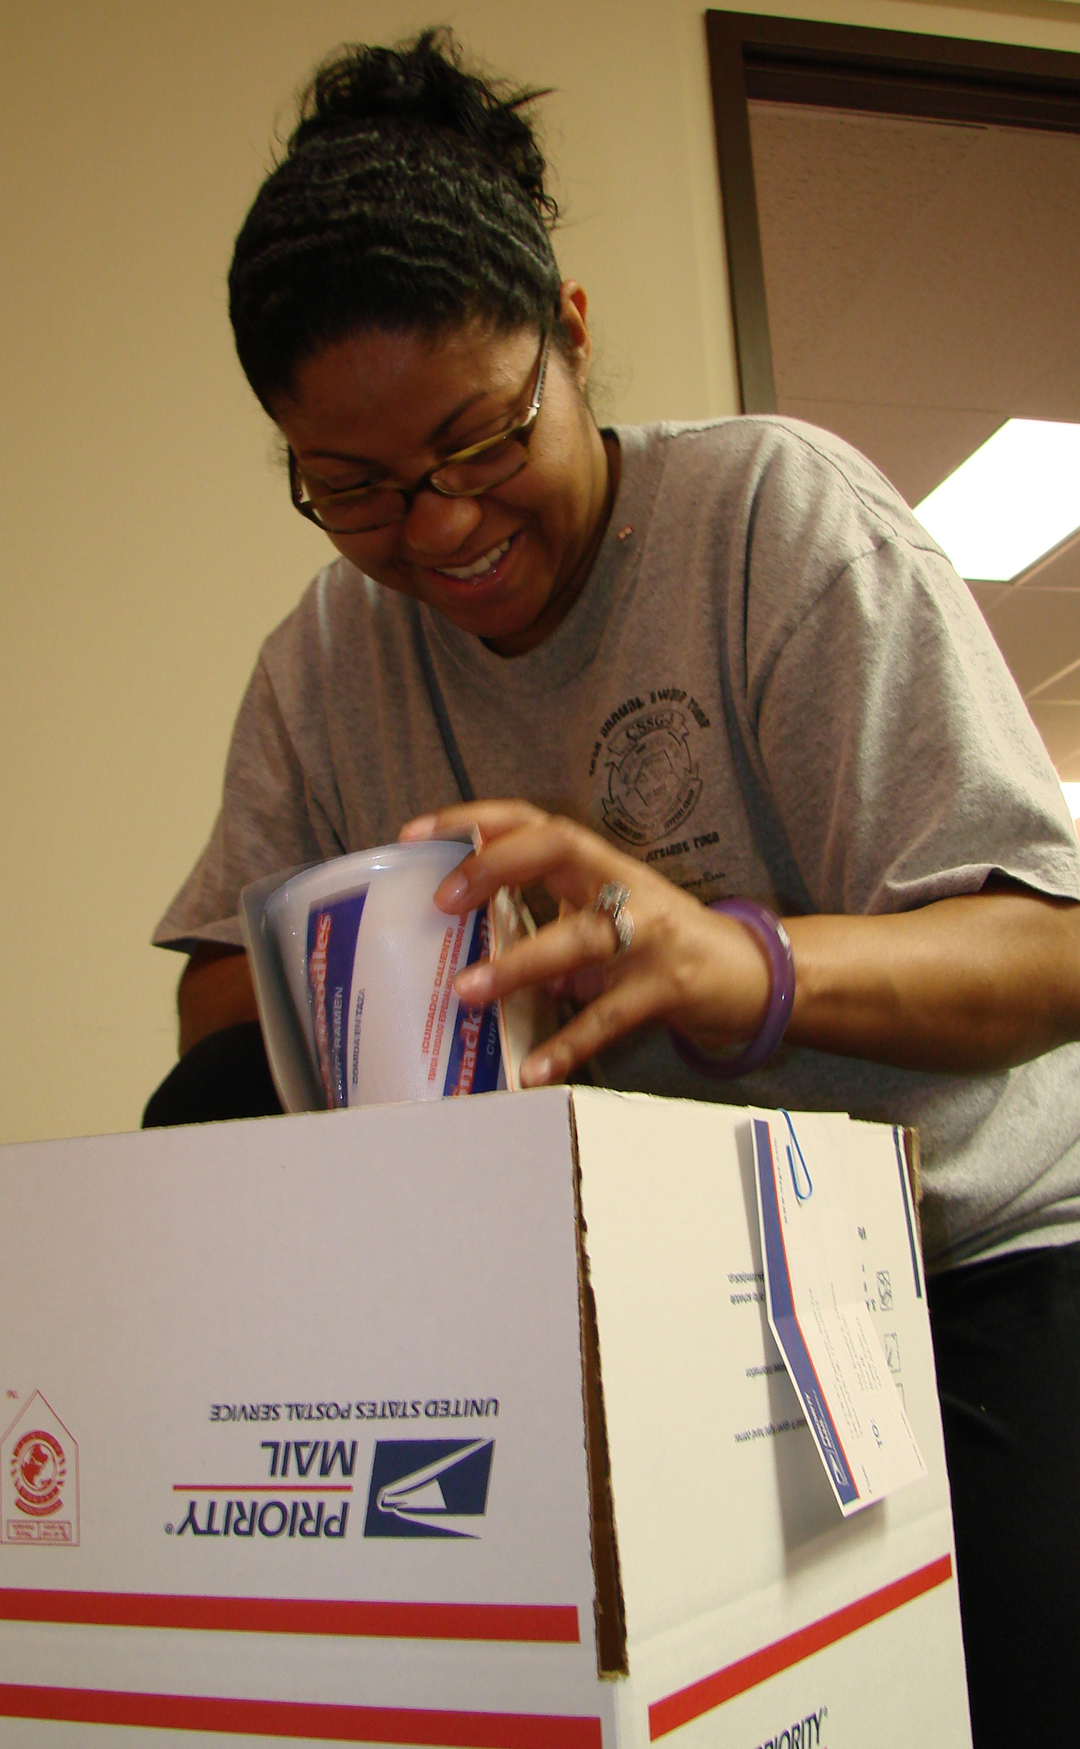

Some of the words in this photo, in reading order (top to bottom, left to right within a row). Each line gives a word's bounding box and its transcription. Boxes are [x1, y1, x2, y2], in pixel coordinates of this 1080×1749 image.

[355, 988, 366, 1020] TAZA
[333, 986, 344, 1049] RAMEN
[486, 1019, 497, 1056] CUP
[209, 1403, 281, 1422] SERVICE
[285, 1402, 352, 1421] POSTAL
[355, 1400, 422, 1419] STATES
[425, 1398, 499, 1418] UNITED
[261, 1441, 358, 1478] MAIL
